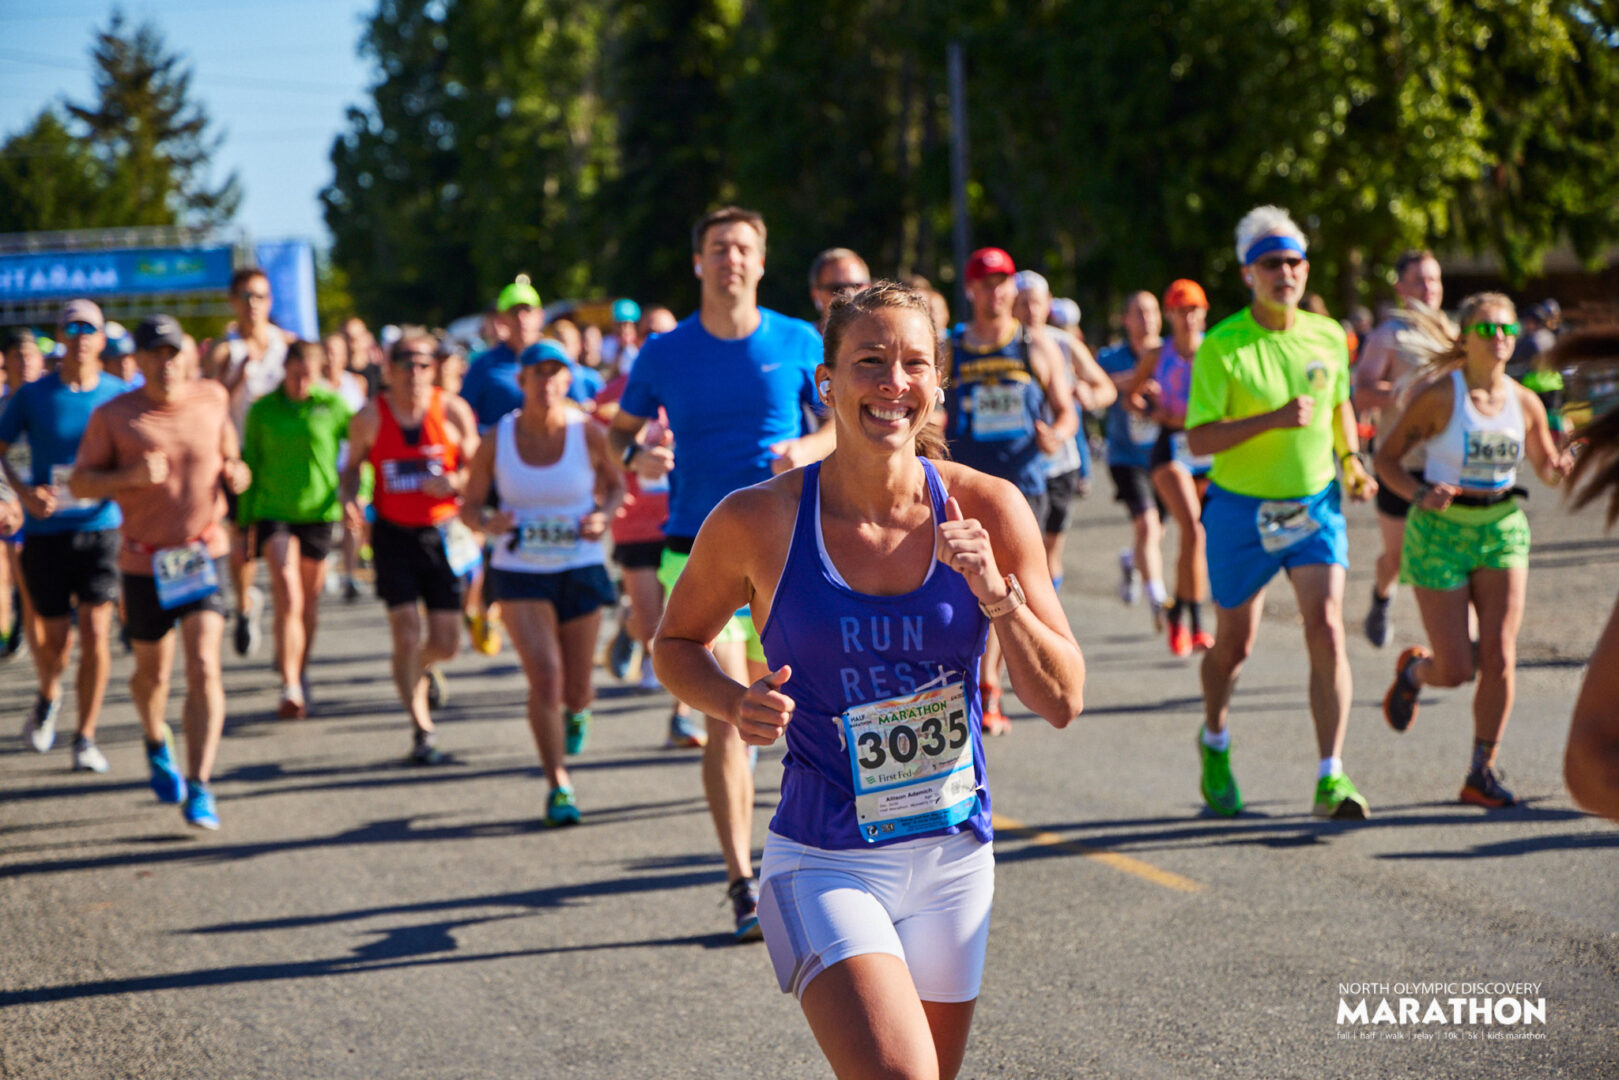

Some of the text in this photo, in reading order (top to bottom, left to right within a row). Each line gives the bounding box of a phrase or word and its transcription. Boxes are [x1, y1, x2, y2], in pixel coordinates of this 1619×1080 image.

[840, 615, 923, 653] RUN
[840, 660, 937, 702] REST
[850, 714, 865, 722] HALF
[878, 700, 947, 725] MARATHON
[857, 709, 968, 769] 3035
[878, 769, 912, 783] First Fed
